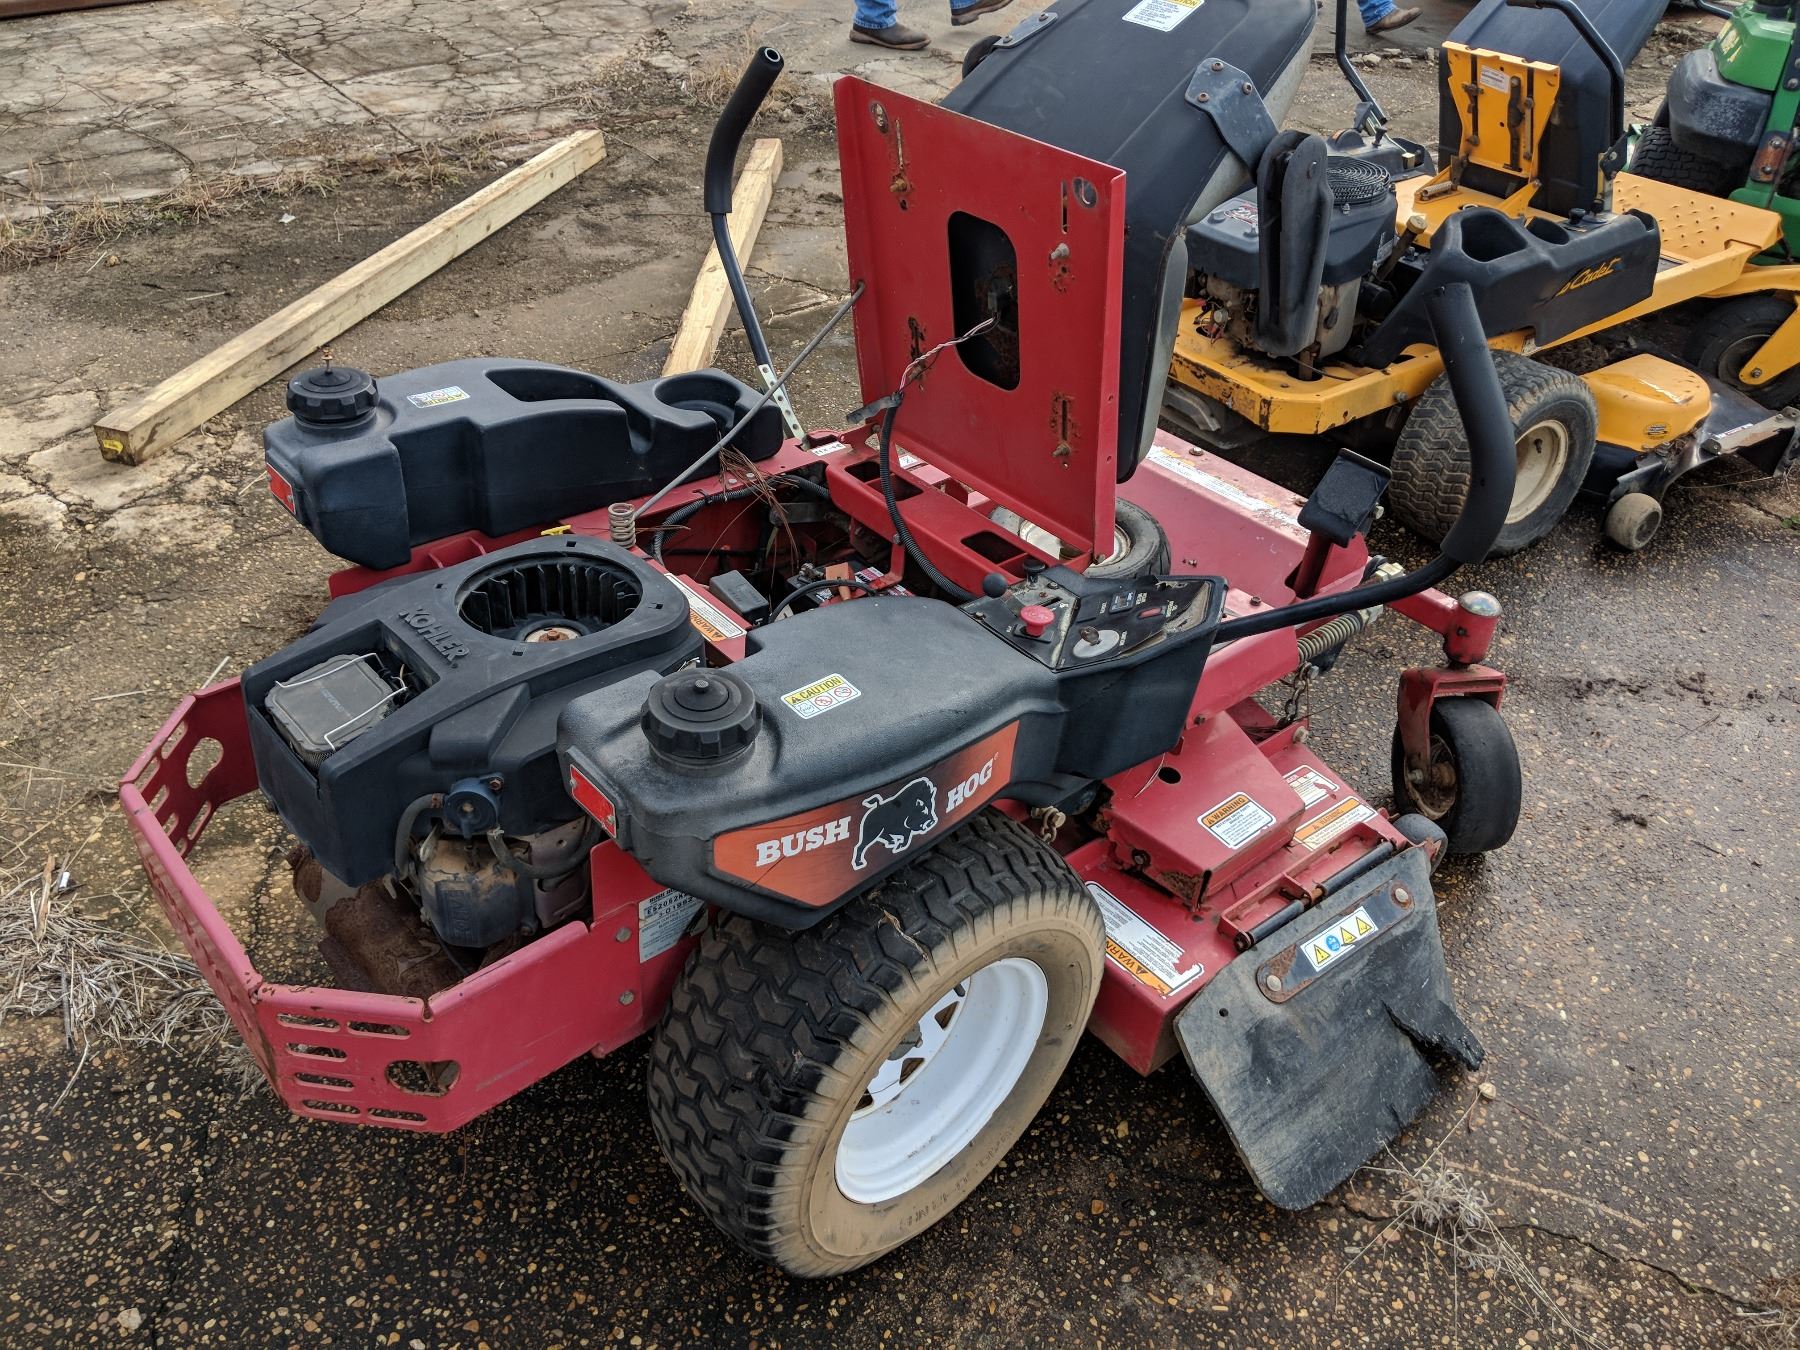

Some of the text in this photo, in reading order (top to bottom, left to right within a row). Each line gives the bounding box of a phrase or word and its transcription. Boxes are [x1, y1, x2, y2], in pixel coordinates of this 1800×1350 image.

[1569, 258, 1621, 289] Cadet
[398, 608, 470, 663] KOHLER
[799, 677, 842, 699] CAUTION
[755, 758, 995, 868] BUSH HOG
[1211, 797, 1246, 820] WARNING
[1106, 940, 1137, 968] WARN
